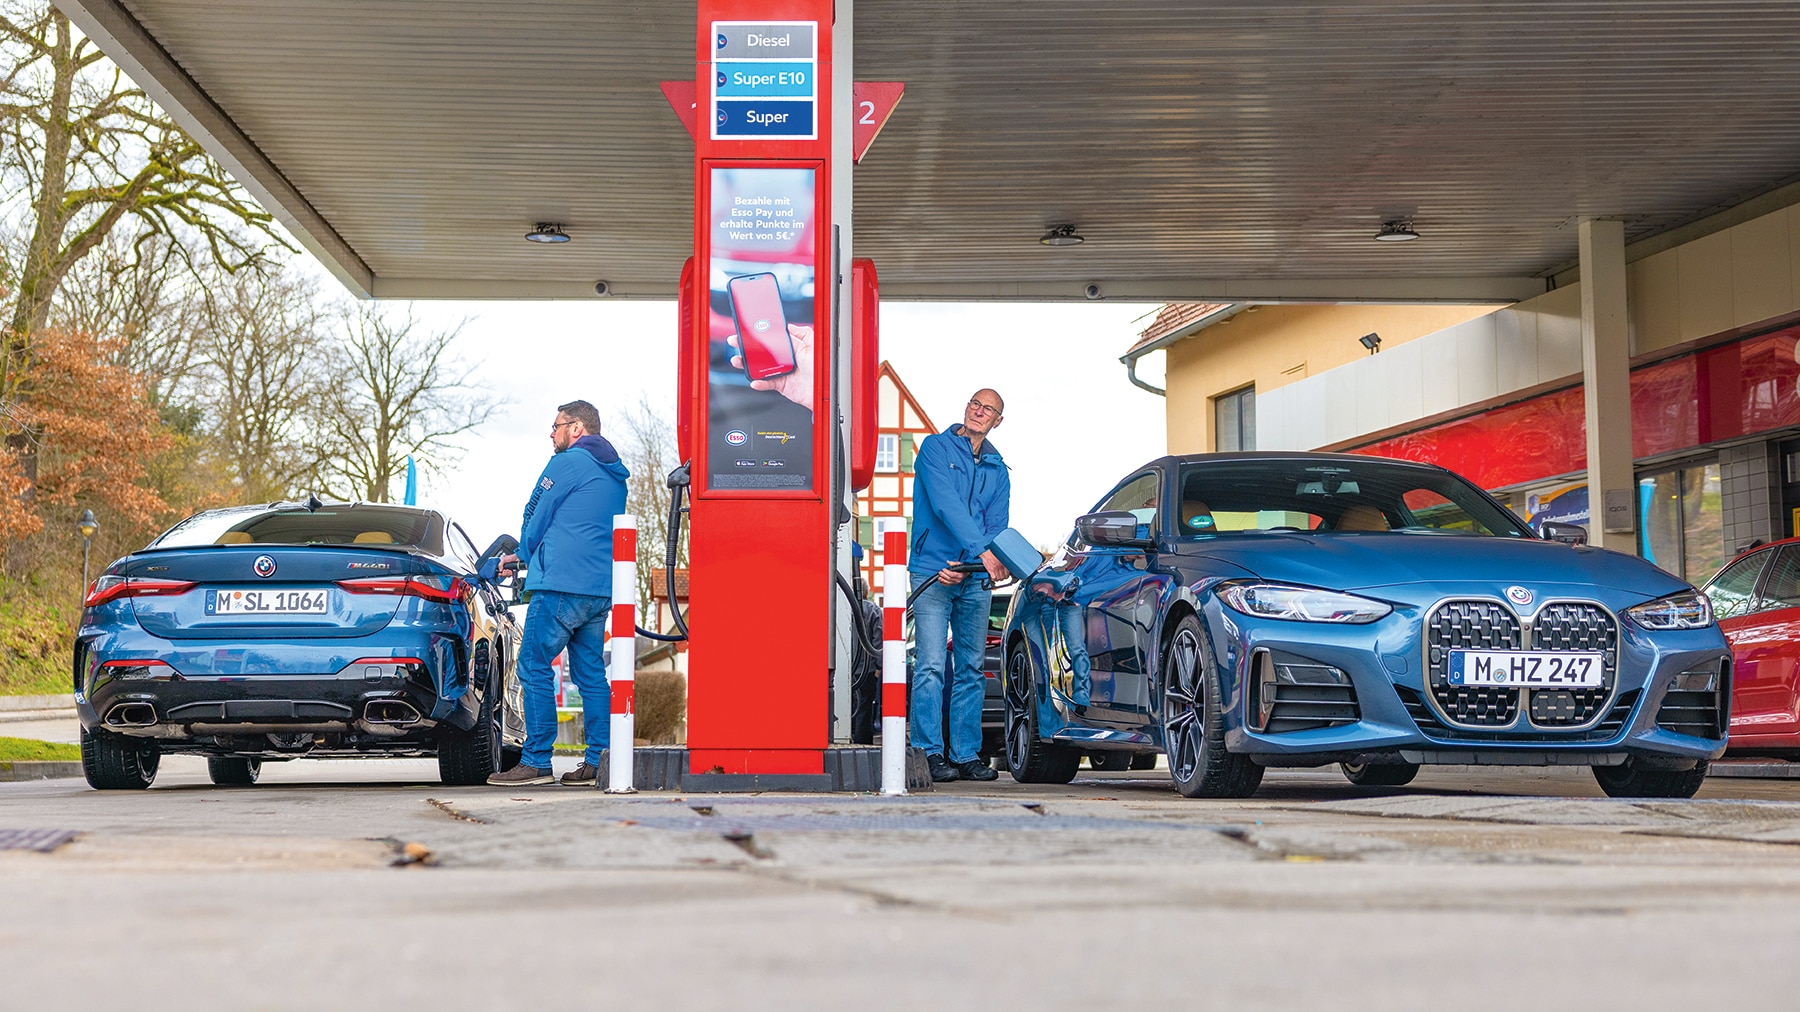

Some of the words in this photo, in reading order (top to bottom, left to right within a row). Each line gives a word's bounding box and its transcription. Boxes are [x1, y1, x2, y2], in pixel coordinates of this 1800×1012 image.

[747, 34, 790, 47] Diesel
[733, 72, 775, 88] Super
[779, 72, 805, 85] E10
[746, 111, 789, 127] Super
[858, 101, 876, 125] 2
[734, 196, 773, 206] Bezahle
[774, 196, 791, 206] mit
[731, 208, 753, 217] Esso
[755, 208, 773, 219] Pay
[775, 208, 794, 217] und
[720, 220, 753, 229] erhalte
[756, 220, 790, 229] Punkte
[792, 220, 805, 229] im
[729, 231, 754, 240] Wert
[217, 592, 230, 611] M
[243, 592, 270, 611] SL
[275, 592, 325, 611] 1064
[1453, 671, 1461, 679] D
[1475, 656, 1492, 681] M
[1510, 657, 1542, 682] HZ
[1548, 658, 1593, 683] 247
